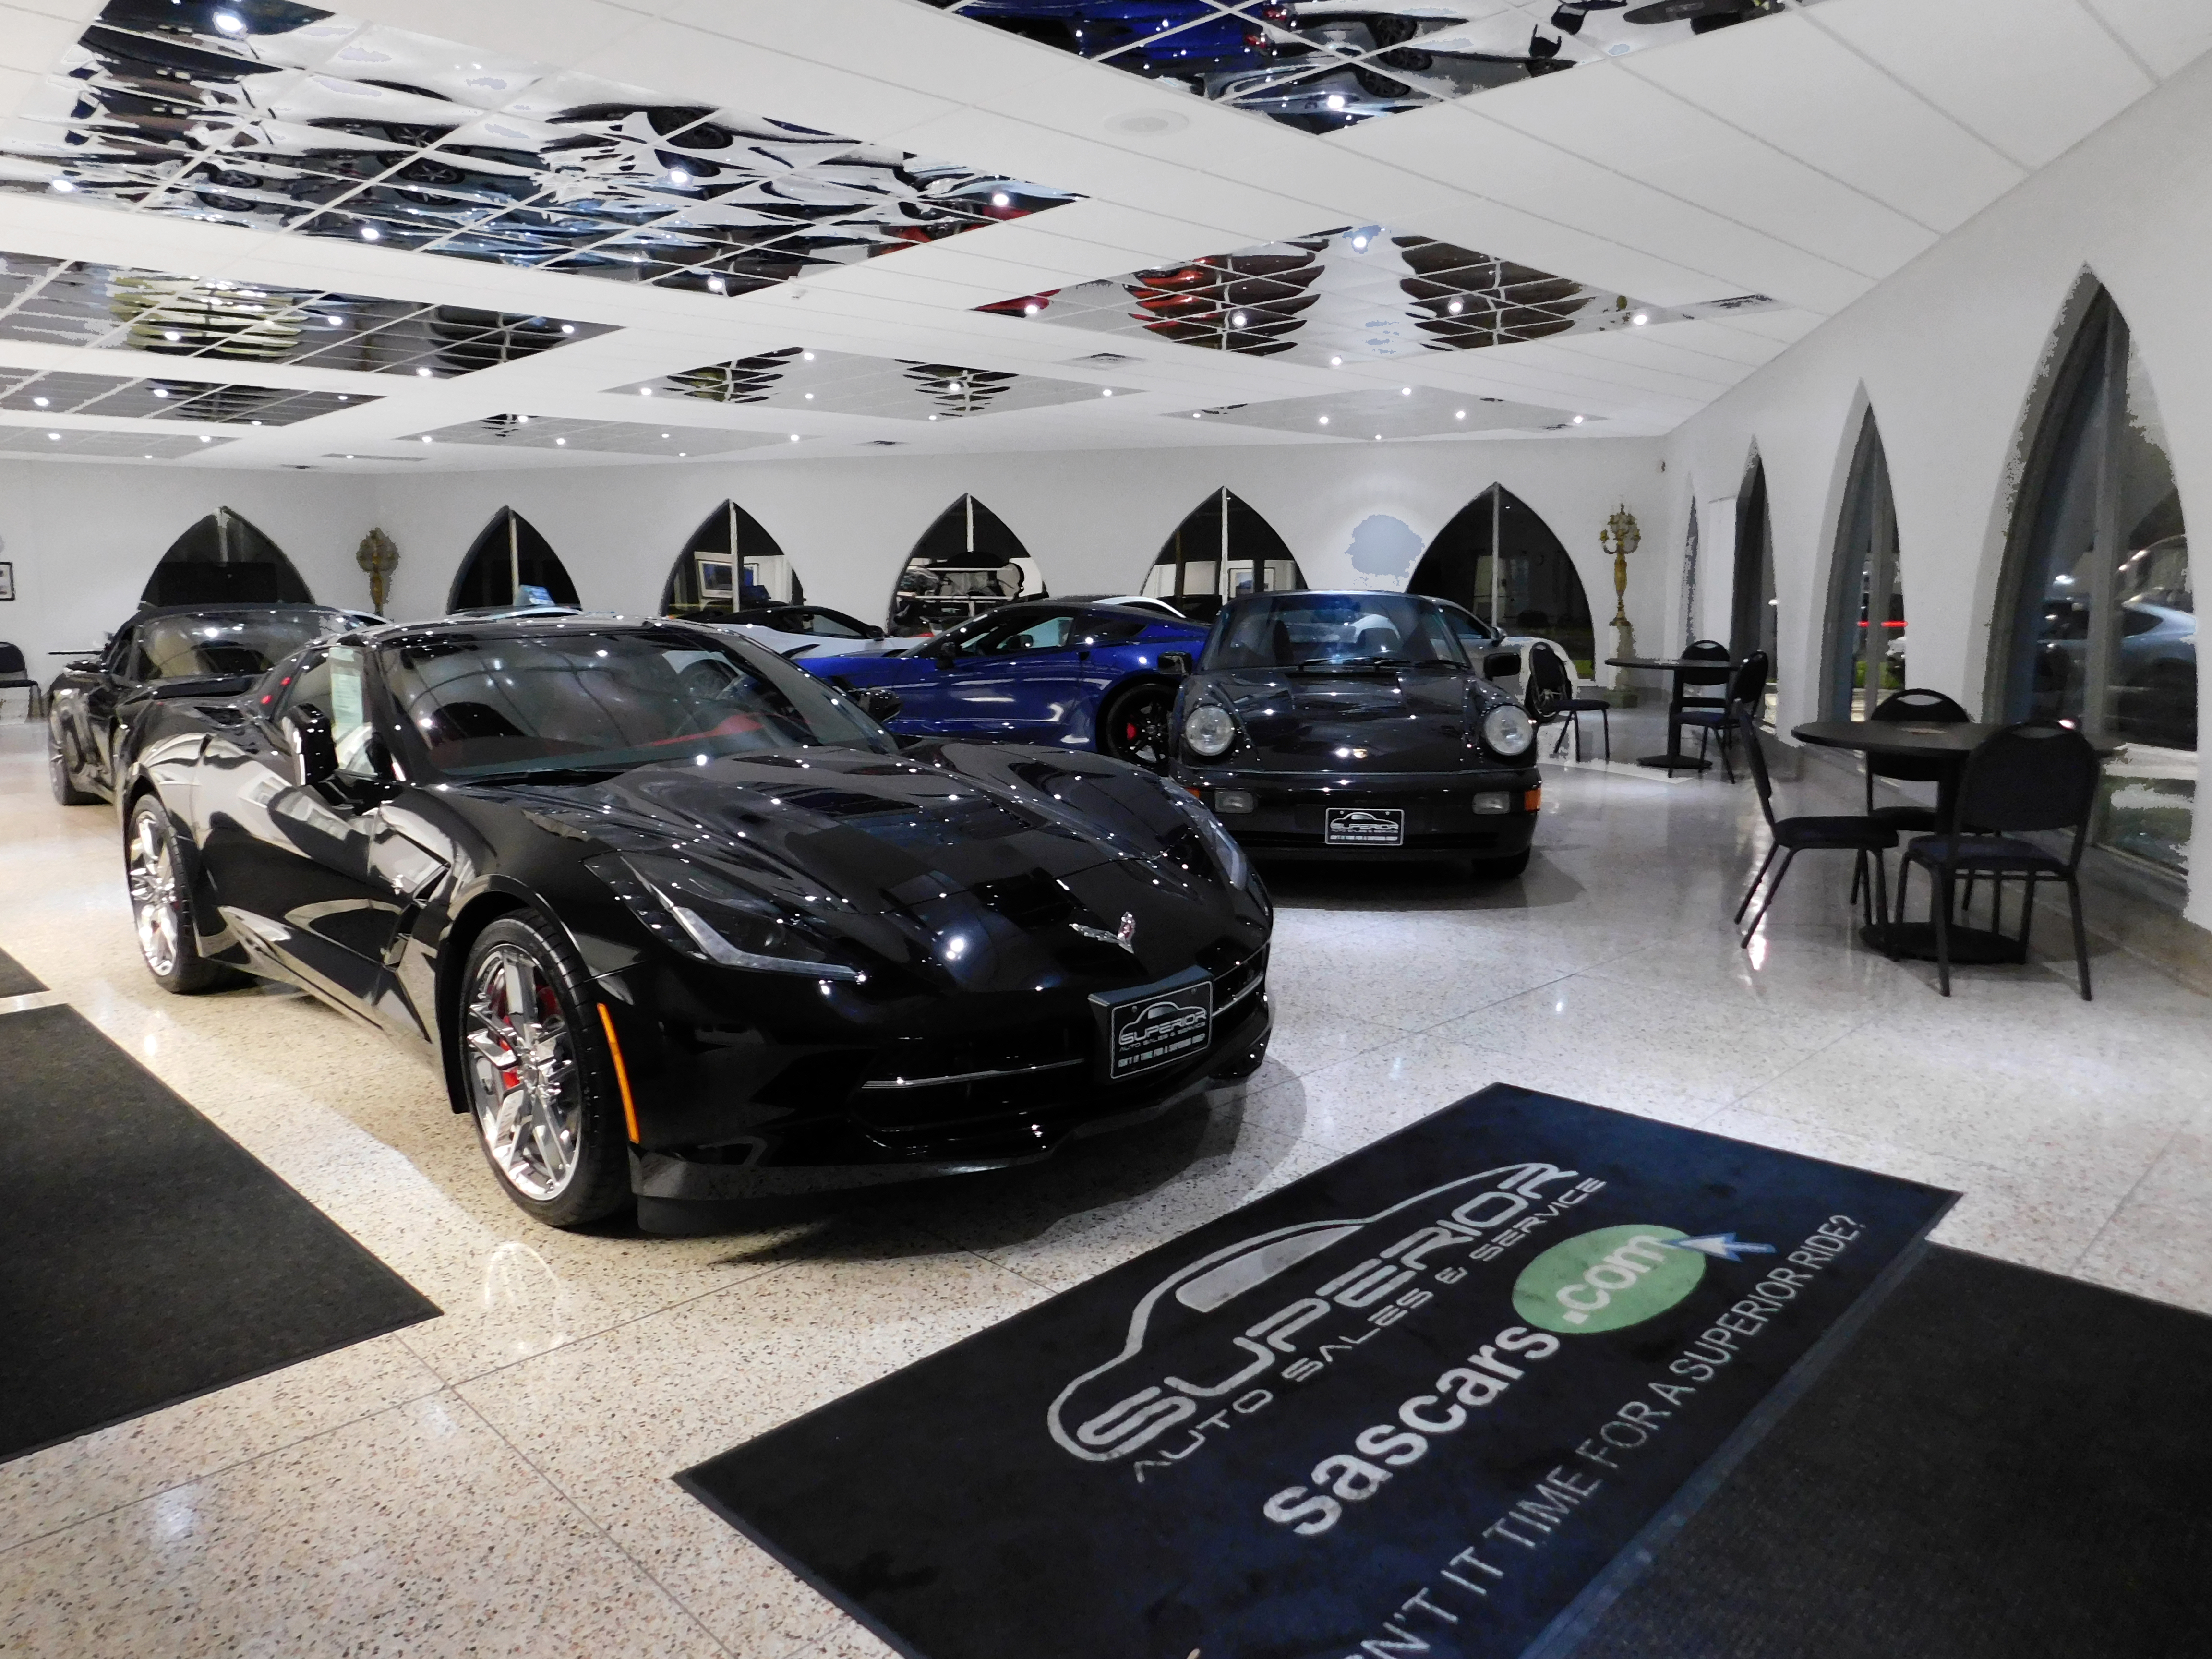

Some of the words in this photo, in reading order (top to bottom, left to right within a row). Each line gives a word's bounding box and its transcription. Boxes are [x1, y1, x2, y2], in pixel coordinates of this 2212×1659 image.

[1118, 1010, 1207, 1045] SUPERIOR
[1788, 1214, 1866, 1270] RIDE?
[1077, 1162, 1578, 1461] SUPERIOR
[1133, 1389, 1273, 1482] AUTO
[1281, 1288, 1434, 1382] SALES
[1435, 1267, 1468, 1284] &
[1469, 1178, 1607, 1262] SERVICE
[1670, 1267, 1814, 1382] SUPERIOR
[1648, 1382, 1696, 1406] A
[1575, 1401, 1671, 1469] FOR
[1482, 1465, 1604, 1548] TIME
[1441, 1546, 1503, 1596] IT
[1344, 1587, 1459, 1659] N'T
